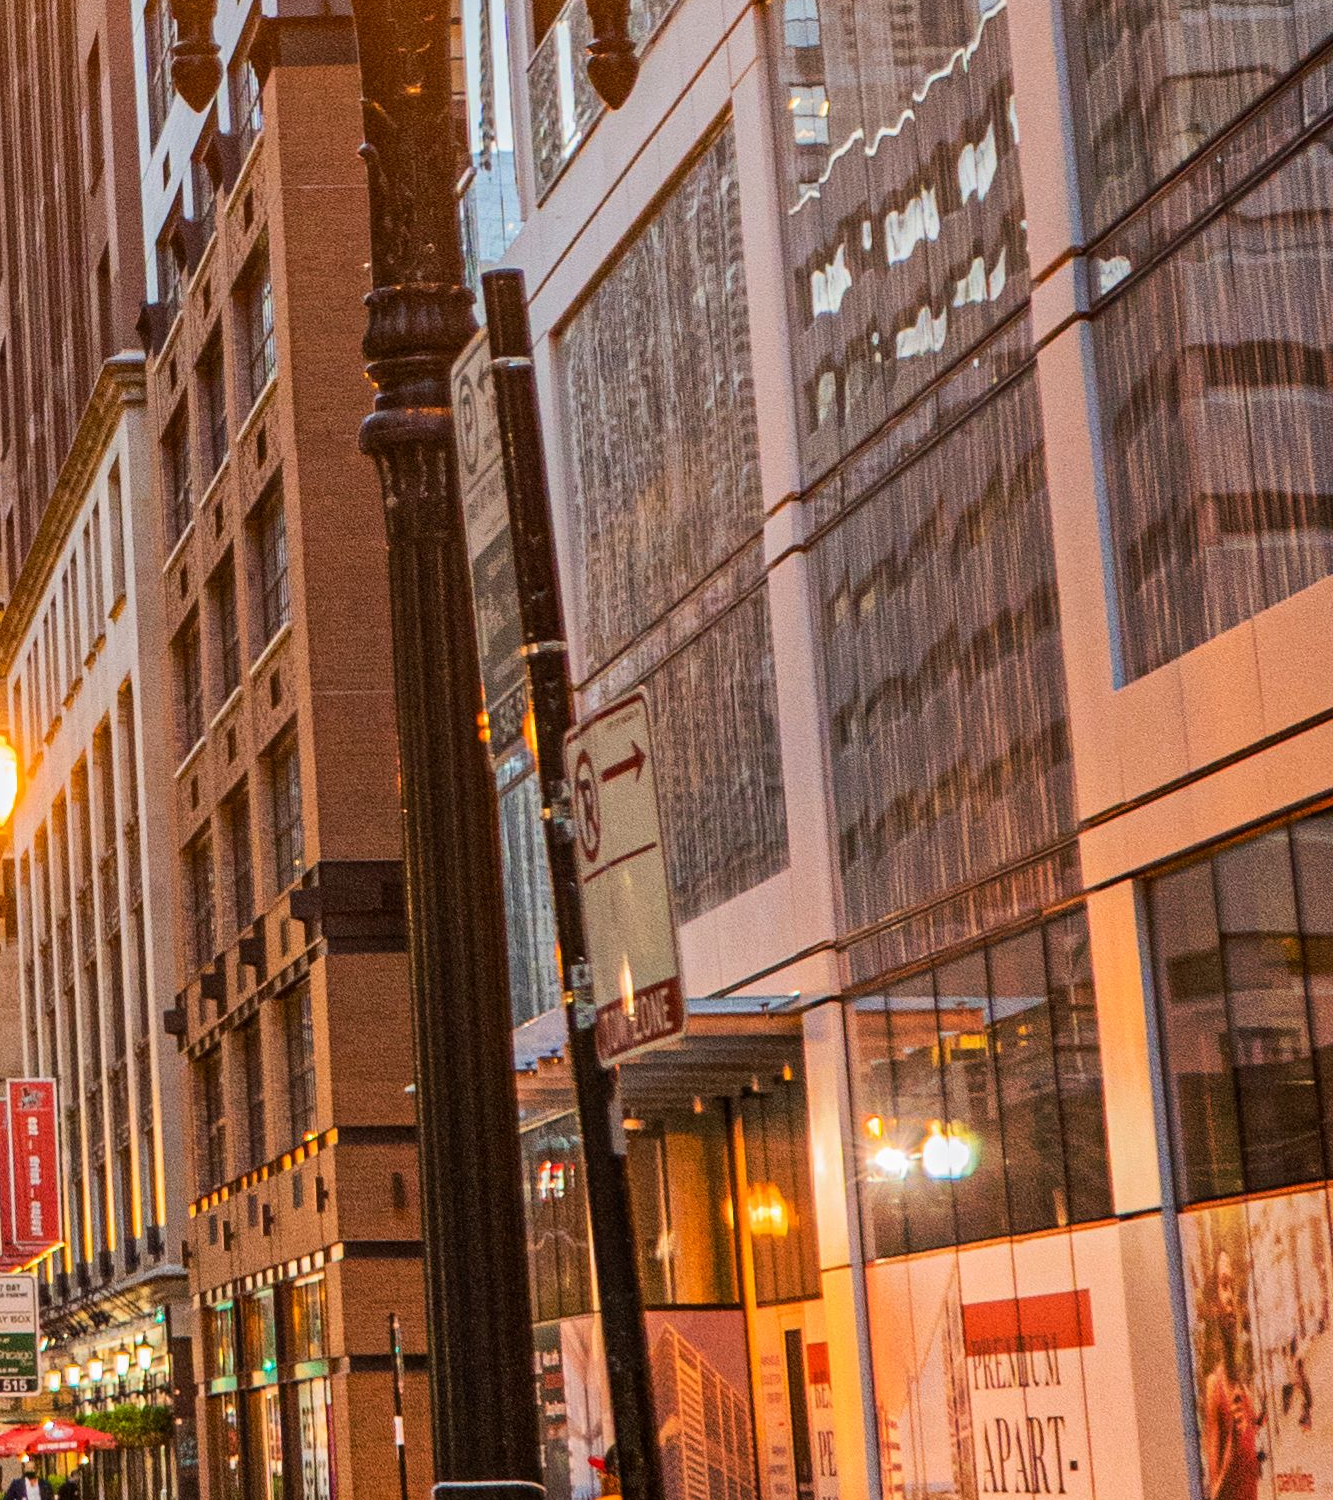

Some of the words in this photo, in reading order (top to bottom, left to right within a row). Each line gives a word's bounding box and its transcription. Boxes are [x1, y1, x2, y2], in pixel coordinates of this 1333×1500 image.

[10, 1314, 31, 1323] BOX
[971, 1332, 1062, 1391] PREMIUM
[2, 1379, 28, 1391] 515
[982, 1415, 1079, 1495] APART-
